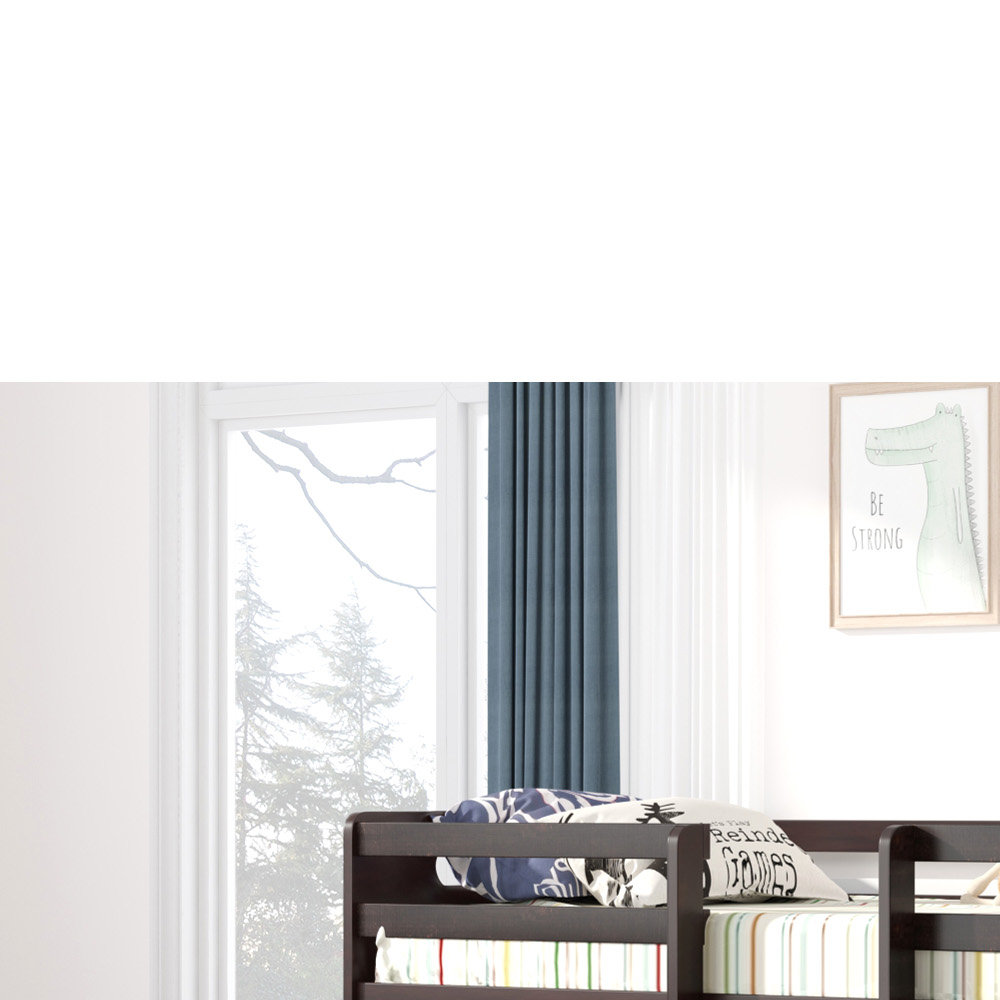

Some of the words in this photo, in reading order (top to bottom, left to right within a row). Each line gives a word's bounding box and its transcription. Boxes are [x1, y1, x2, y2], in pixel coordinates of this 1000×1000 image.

[870, 491, 884, 516] BE
[851, 526, 903, 551] STRONG
[709, 827, 795, 847] Reinde
